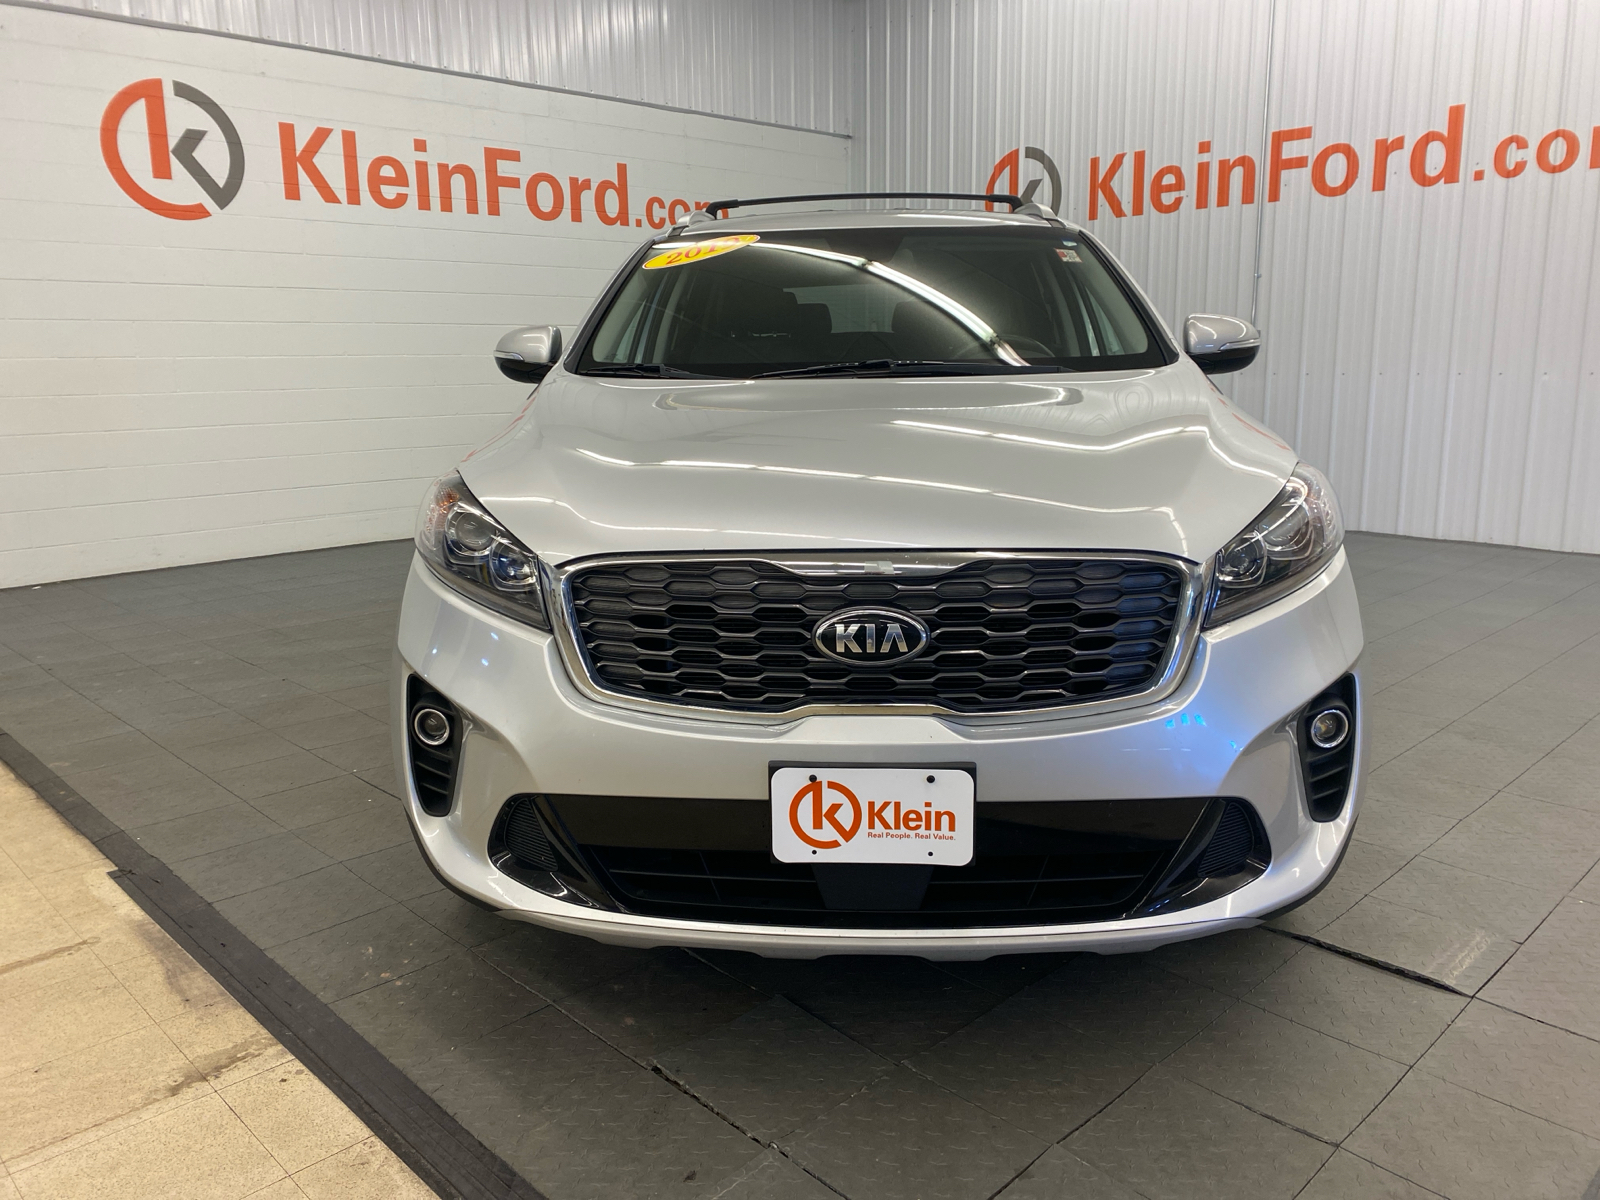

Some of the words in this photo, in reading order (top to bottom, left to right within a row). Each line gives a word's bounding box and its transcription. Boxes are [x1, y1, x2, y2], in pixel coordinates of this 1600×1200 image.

[1087, 103, 1600, 221] KleinFord.co
[834, 623, 909, 654] KIA
[867, 801, 956, 832] Klein
[867, 831, 884, 839] Real
[885, 832, 913, 840] People.
[933, 833, 956, 841] Value.
